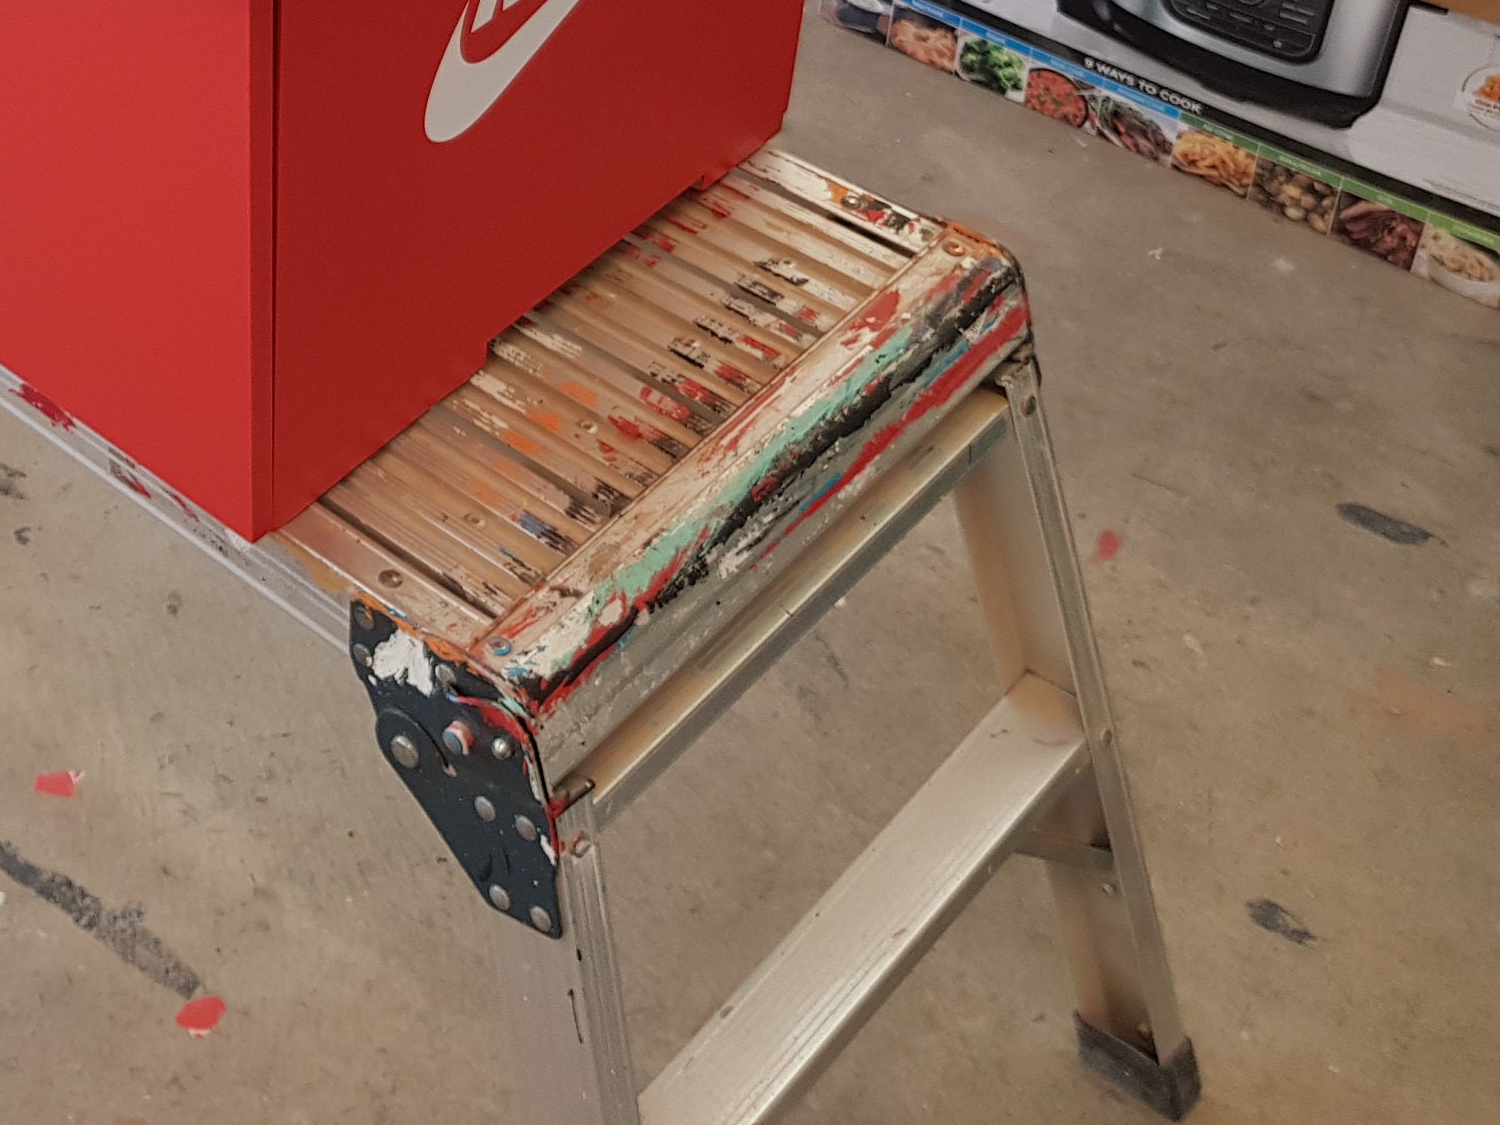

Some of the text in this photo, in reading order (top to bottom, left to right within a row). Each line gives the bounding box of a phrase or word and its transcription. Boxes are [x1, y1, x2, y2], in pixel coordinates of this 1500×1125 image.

[1084, 57, 1094, 69] 9
[1096, 63, 1136, 87] WAYS
[1138, 81, 1157, 96] TO
[1158, 88, 1202, 115] COOK
